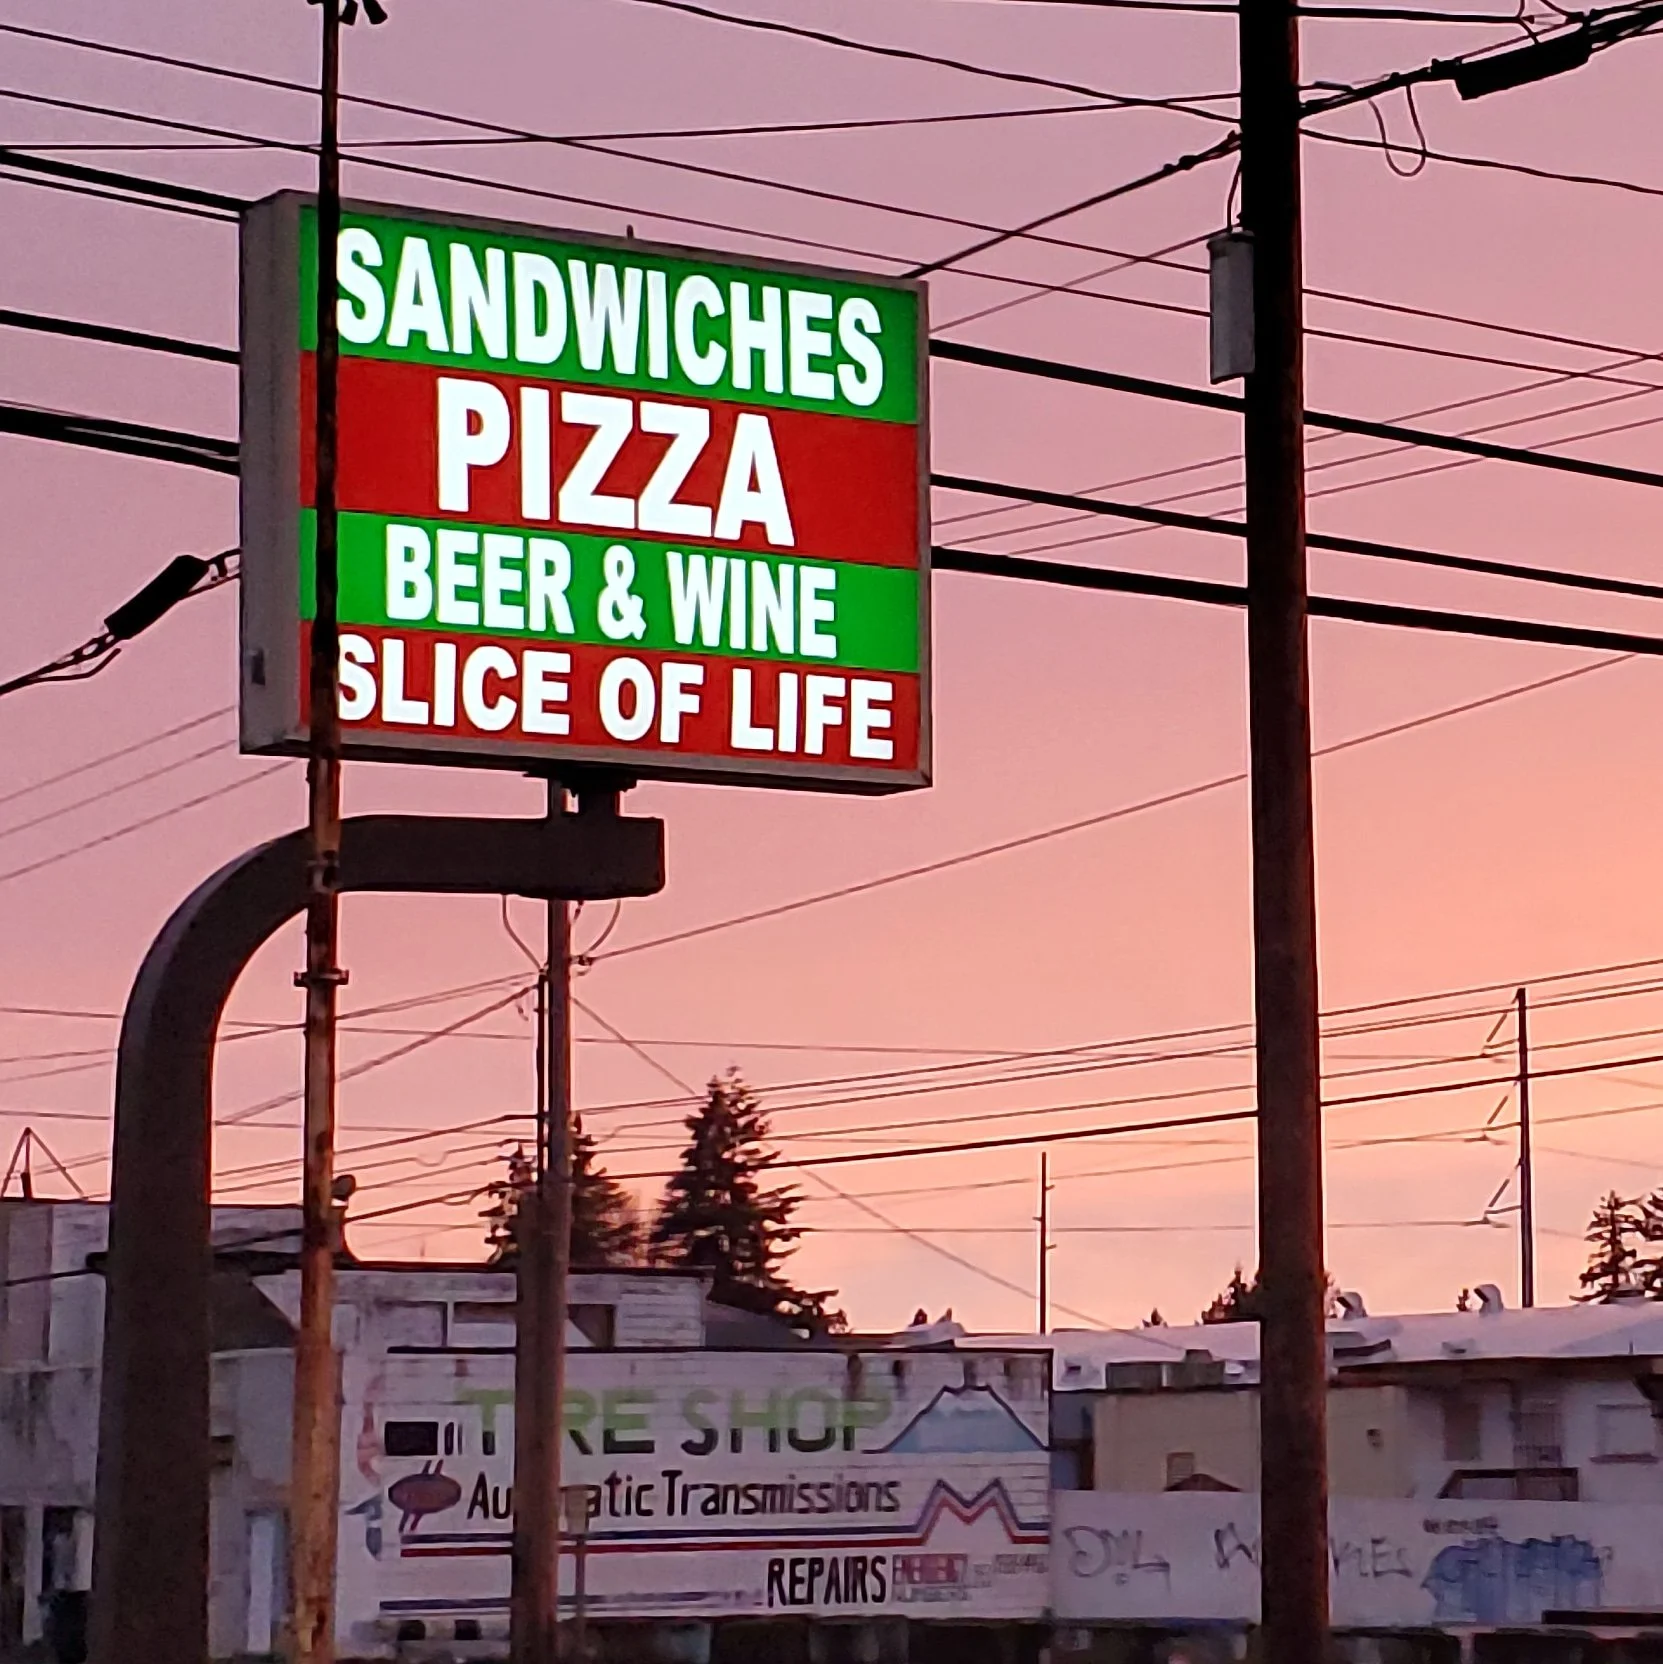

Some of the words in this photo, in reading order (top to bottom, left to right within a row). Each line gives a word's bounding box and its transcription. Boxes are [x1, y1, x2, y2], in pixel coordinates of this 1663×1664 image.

[336, 227, 884, 407] SANDWICHES
[437, 377, 795, 547] PIZZA
[386, 524, 575, 634] BEER
[598, 545, 647, 641] &
[666, 551, 838, 660] WINE
[338, 634, 572, 736] SLICE
[599, 657, 704, 743] OF
[731, 668, 893, 760] LIFE
[456, 1388, 655, 1456] TRE
[681, 1386, 892, 1456] SHOP
[467, 1470, 655, 1520] Auatic
[661, 1469, 901, 1518] Transmissions
[767, 1555, 887, 1608] REPAIRS
